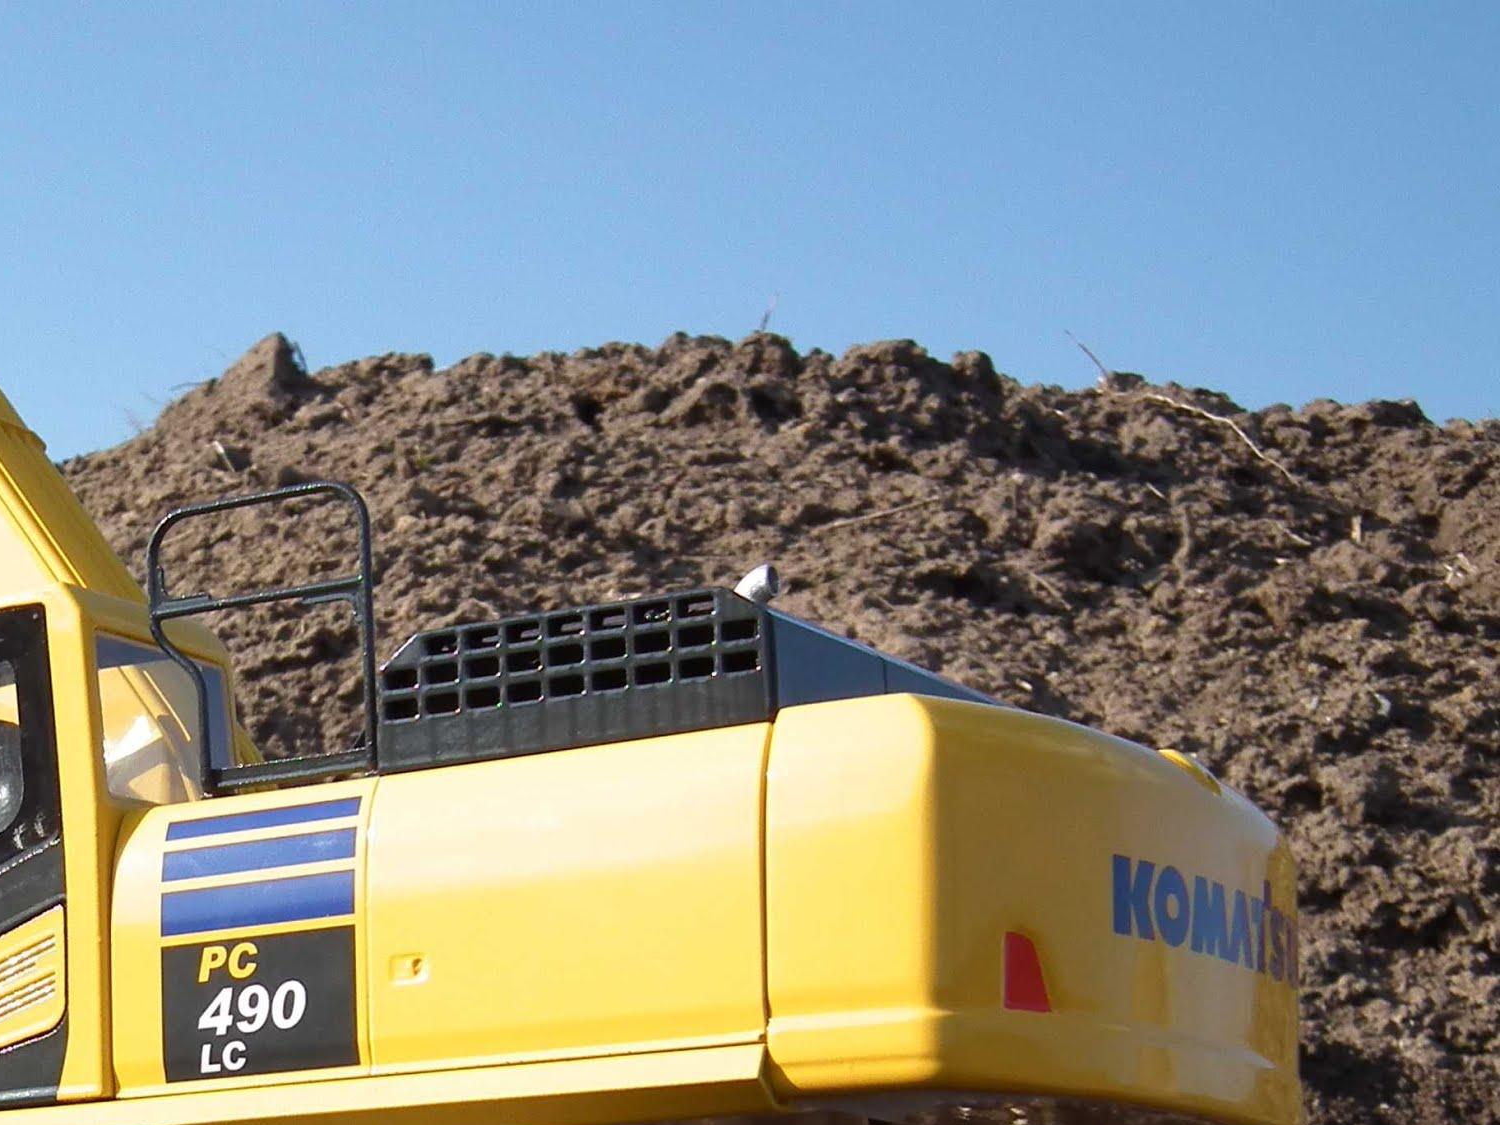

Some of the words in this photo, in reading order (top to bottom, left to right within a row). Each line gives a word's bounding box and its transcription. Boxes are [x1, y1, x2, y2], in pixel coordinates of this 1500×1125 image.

[198, 942, 258, 983] PC
[198, 980, 307, 1036] 490
[200, 1041, 247, 1074] LC
